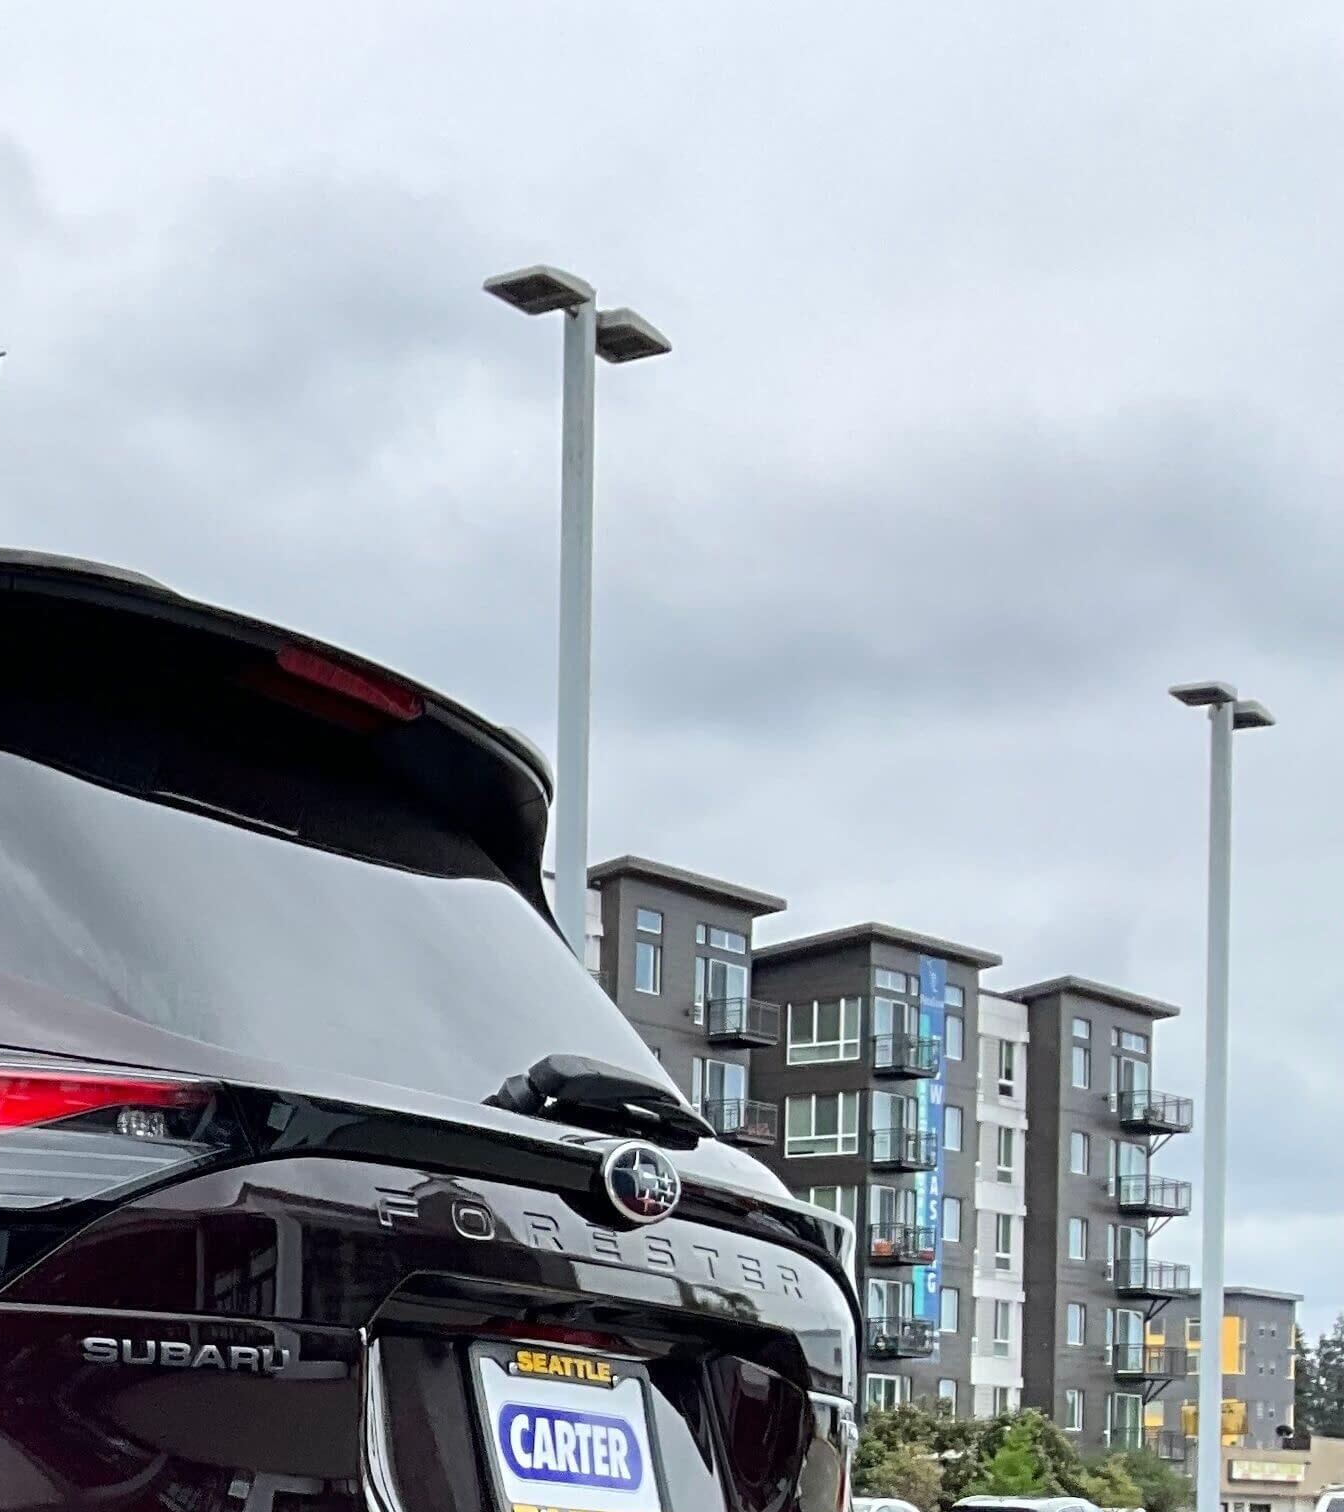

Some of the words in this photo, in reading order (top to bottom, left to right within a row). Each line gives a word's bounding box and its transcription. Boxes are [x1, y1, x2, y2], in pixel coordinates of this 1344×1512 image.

[375, 1186, 803, 1299] FORESTER
[82, 1337, 291, 1372] SUBARU
[516, 1350, 613, 1383] SEATTLE
[510, 1412, 632, 1481] CARTER
